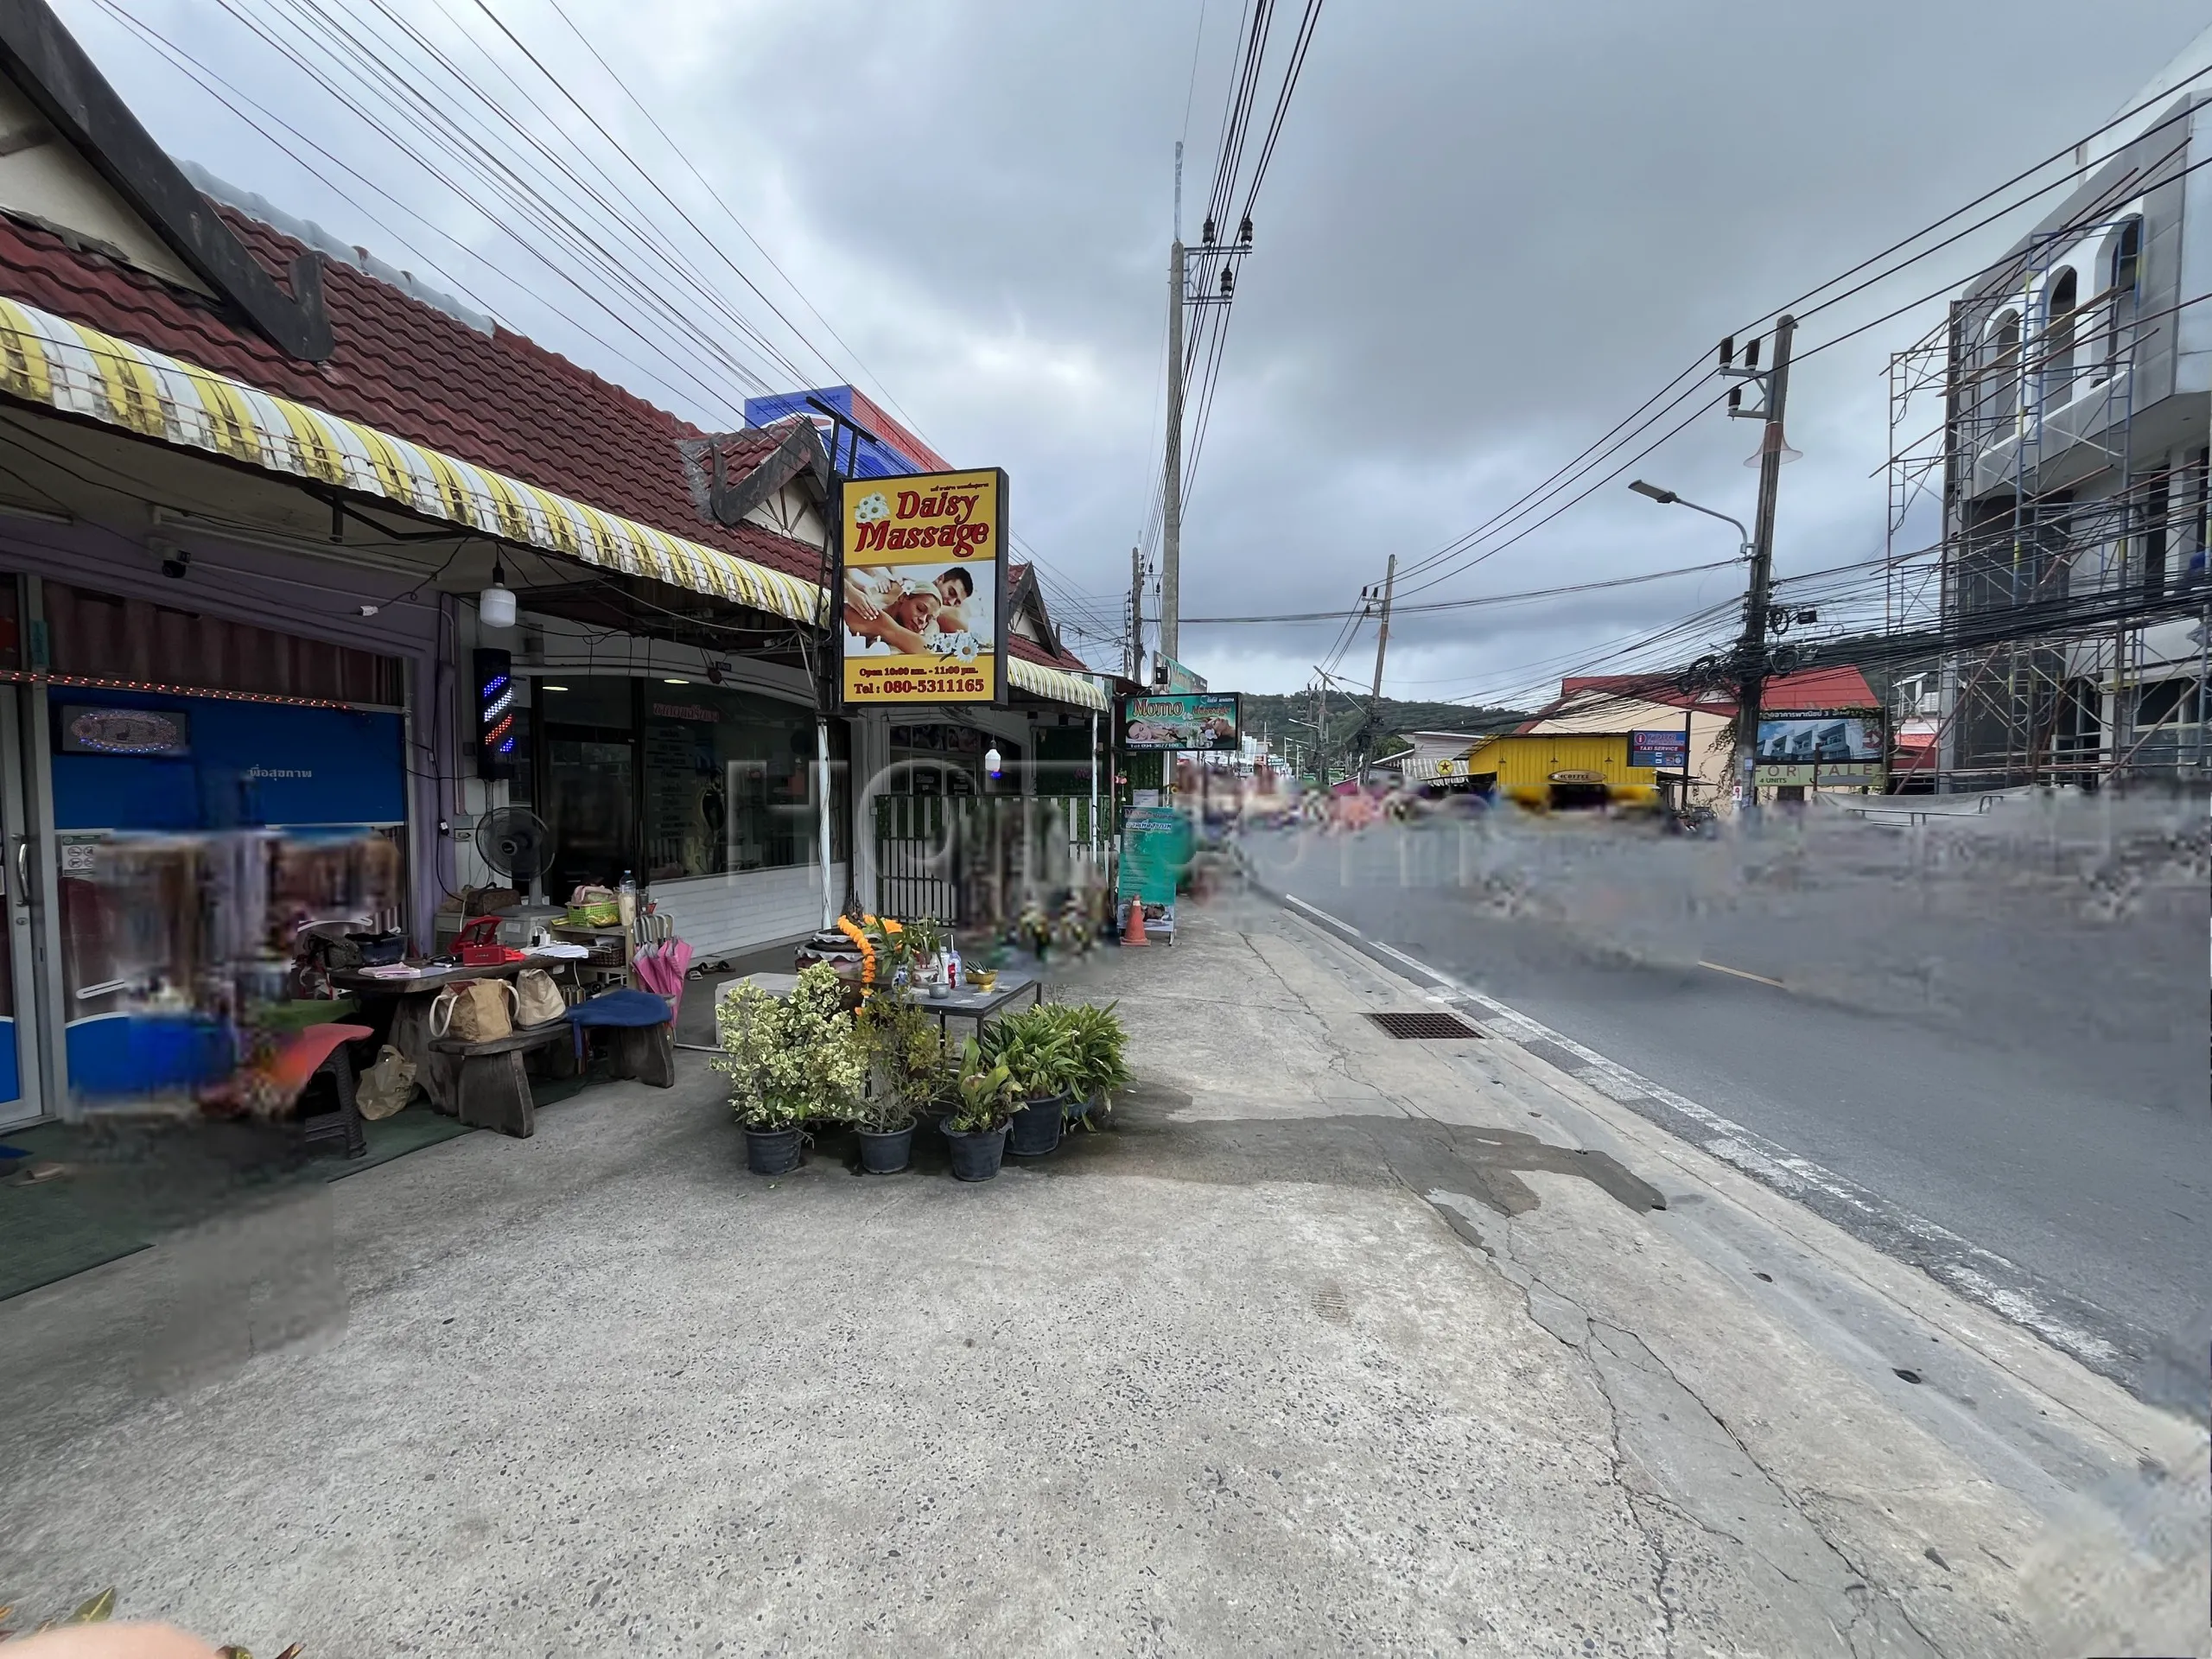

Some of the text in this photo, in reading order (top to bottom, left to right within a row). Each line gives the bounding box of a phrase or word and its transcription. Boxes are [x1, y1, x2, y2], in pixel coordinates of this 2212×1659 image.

[896, 491, 980, 525] Daisy
[854, 520, 990, 558] Massage
[859, 668, 883, 678] Open
[884, 667, 910, 677] 10:00
[934, 666, 960, 675] 11:00
[854, 683, 874, 695] Tel
[883, 678, 985, 695] 080-5311165
[1132, 698, 1185, 717] Momo
[1755, 765, 1797, 777] FOR
